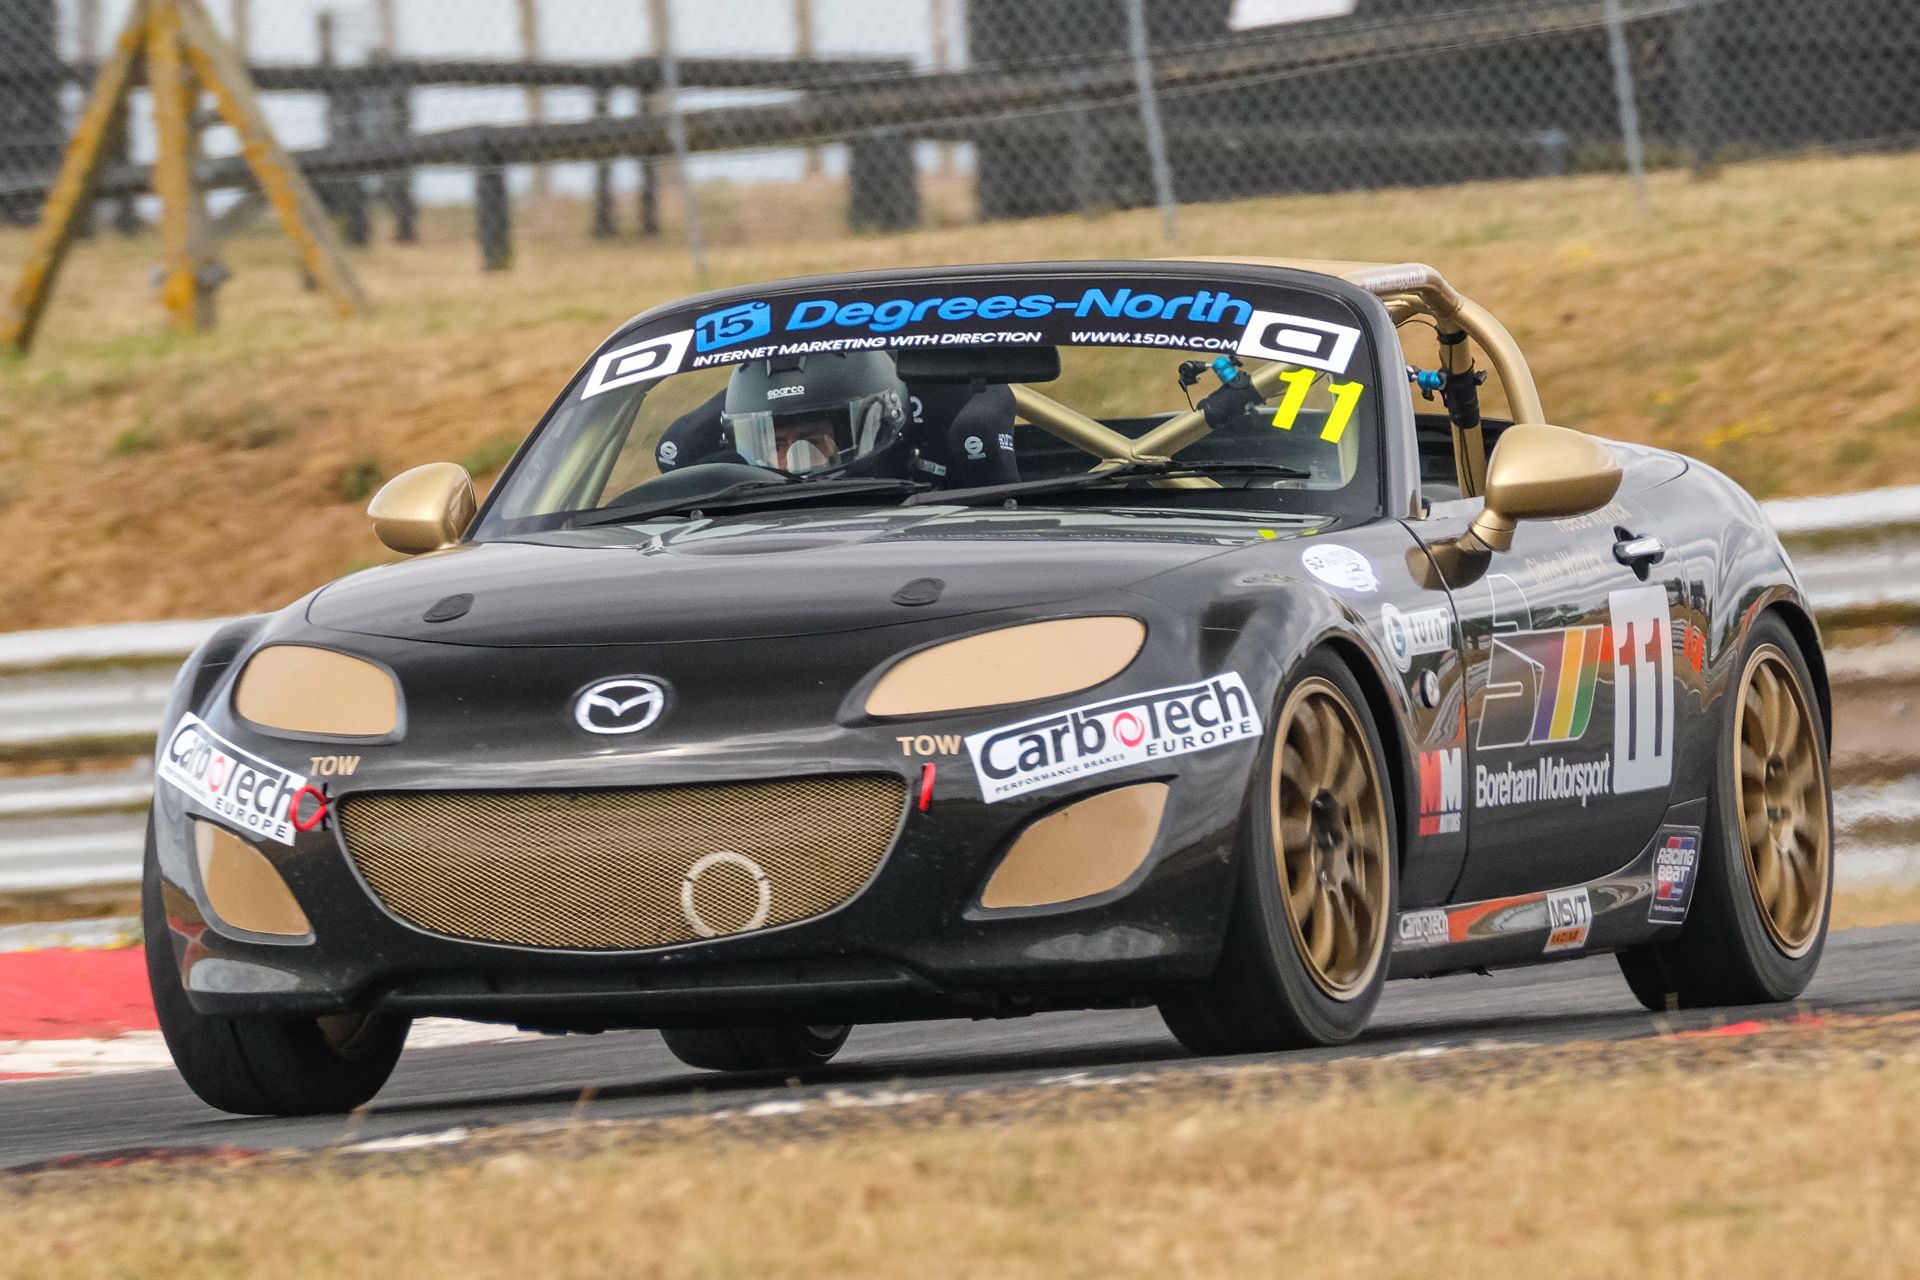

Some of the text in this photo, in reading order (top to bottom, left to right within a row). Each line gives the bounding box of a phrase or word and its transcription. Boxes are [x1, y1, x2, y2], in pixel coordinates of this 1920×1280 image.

[785, 287, 1252, 333] Degrees-North
[693, 331, 1042, 367] INTERNET MARKETING WITH DIRECTION
[1071, 331, 1239, 351] WWW.15DN.COM
[767, 385, 805, 400] sparco
[1272, 367, 1365, 445] 11
[1619, 618, 1663, 761] 11
[896, 734, 962, 757] TOW
[1146, 720, 1253, 757] EUROPE
[310, 755, 361, 777] TOW
[995, 752, 1127, 794] PERFORMANCE BRAKES
[1475, 751, 1610, 808] Boreham Motorsport
[214, 796, 287, 839] EUROPE
[1549, 894, 1587, 928] MSVT
